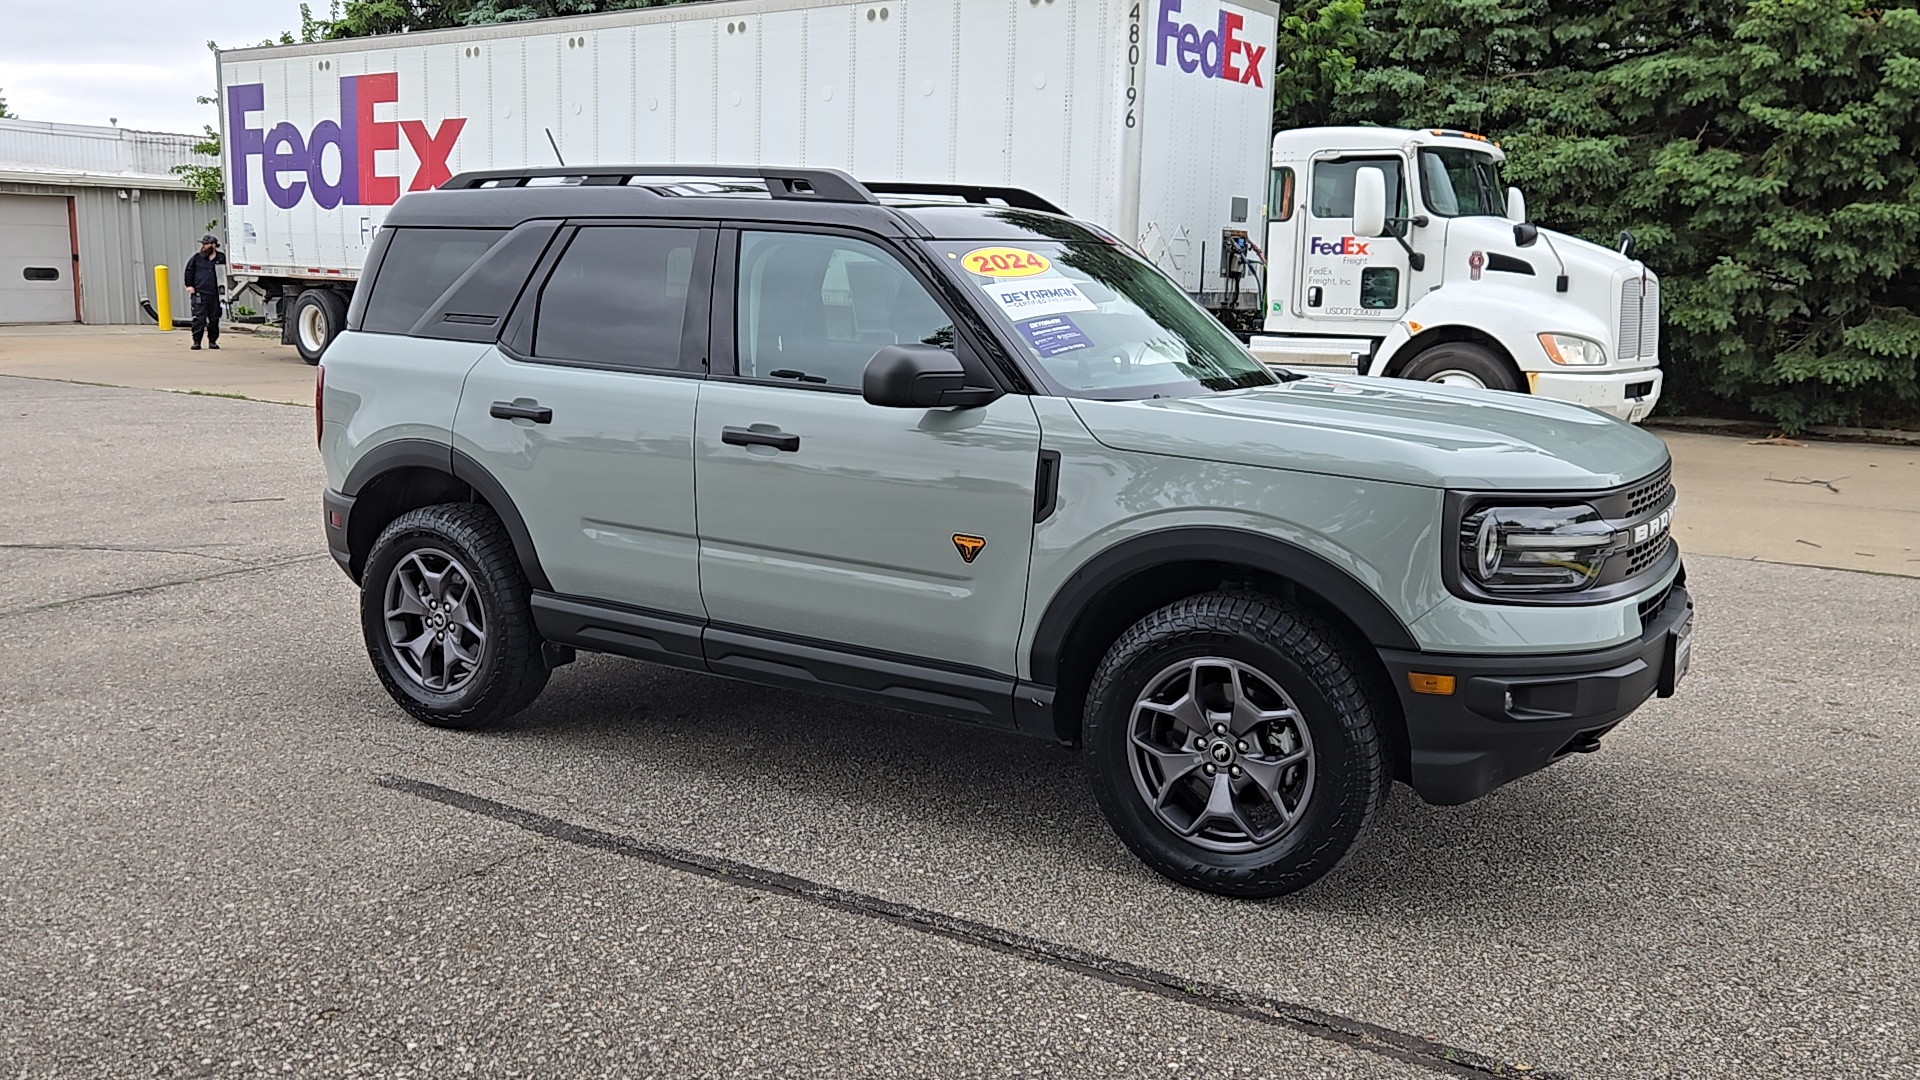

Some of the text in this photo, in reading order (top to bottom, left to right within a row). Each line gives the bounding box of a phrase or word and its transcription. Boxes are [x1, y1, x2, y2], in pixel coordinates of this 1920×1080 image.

[1156, 0, 1266, 88] FedEx
[1125, 3, 1140, 128] 480196
[227, 72, 467, 209] FedEx
[361, 217, 382, 245] Fr
[1311, 237, 1369, 255] FedEx
[973, 253, 1045, 273] 2024
[1343, 257, 1368, 266] Freight
[1309, 267, 1333, 275] FedEx
[1340, 277, 1353, 285] Inc.
[1001, 288, 1077, 304] DEYARMAN
[1325, 307, 1352, 315] USDOT
